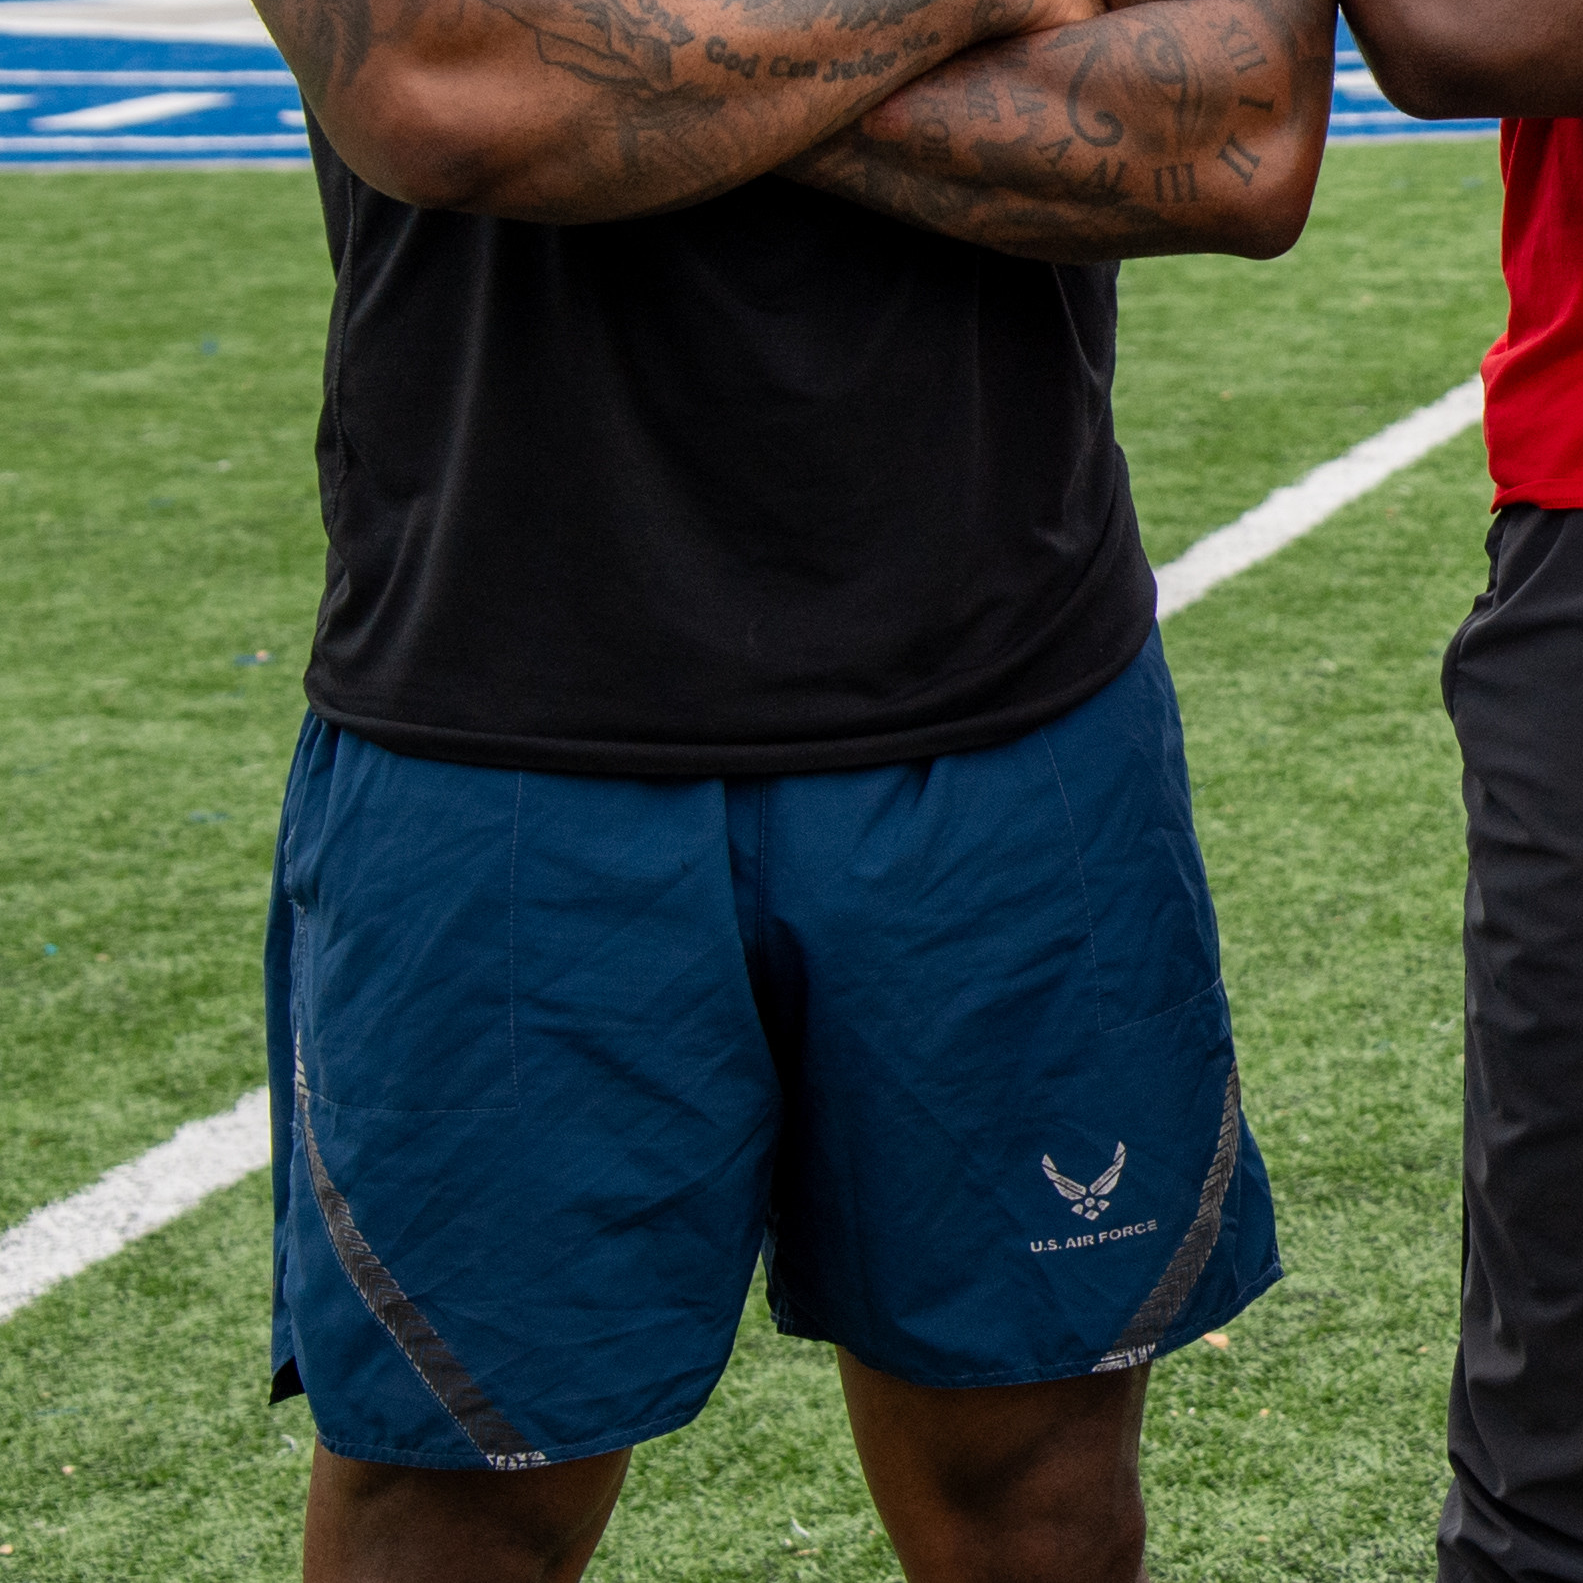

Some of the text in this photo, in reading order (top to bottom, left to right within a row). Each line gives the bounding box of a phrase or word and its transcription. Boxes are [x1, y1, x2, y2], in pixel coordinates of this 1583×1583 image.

[705, 35, 760, 80] God
[1030, 1219, 1158, 1253] U.S. AIR FORCE
